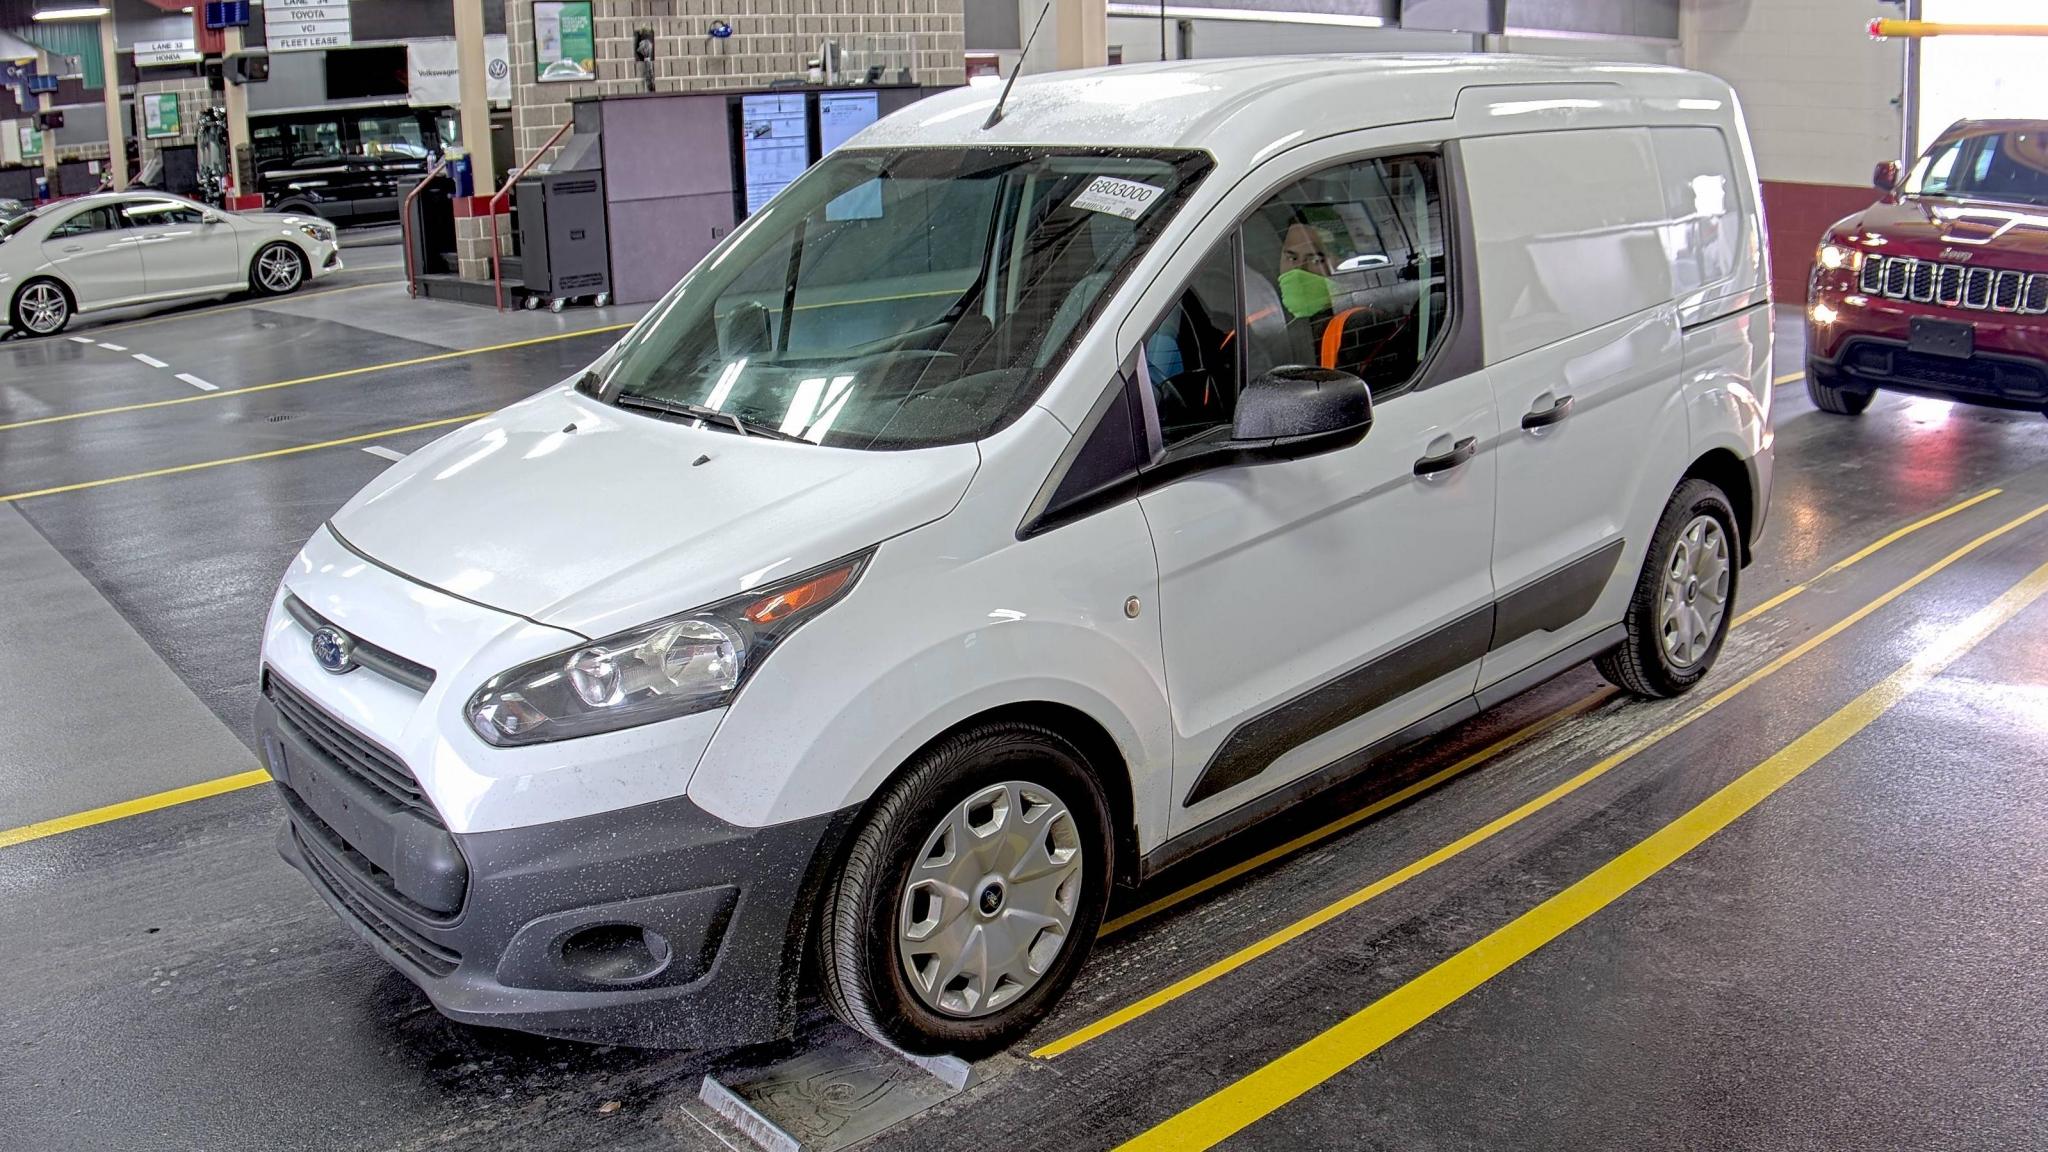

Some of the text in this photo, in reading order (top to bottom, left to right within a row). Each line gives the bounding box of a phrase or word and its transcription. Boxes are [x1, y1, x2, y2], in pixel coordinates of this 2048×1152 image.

[291, 10, 325, 19] TOYOTA
[281, 37, 337, 47] FLEET LEASE
[1089, 180, 1152, 201] 6803000
